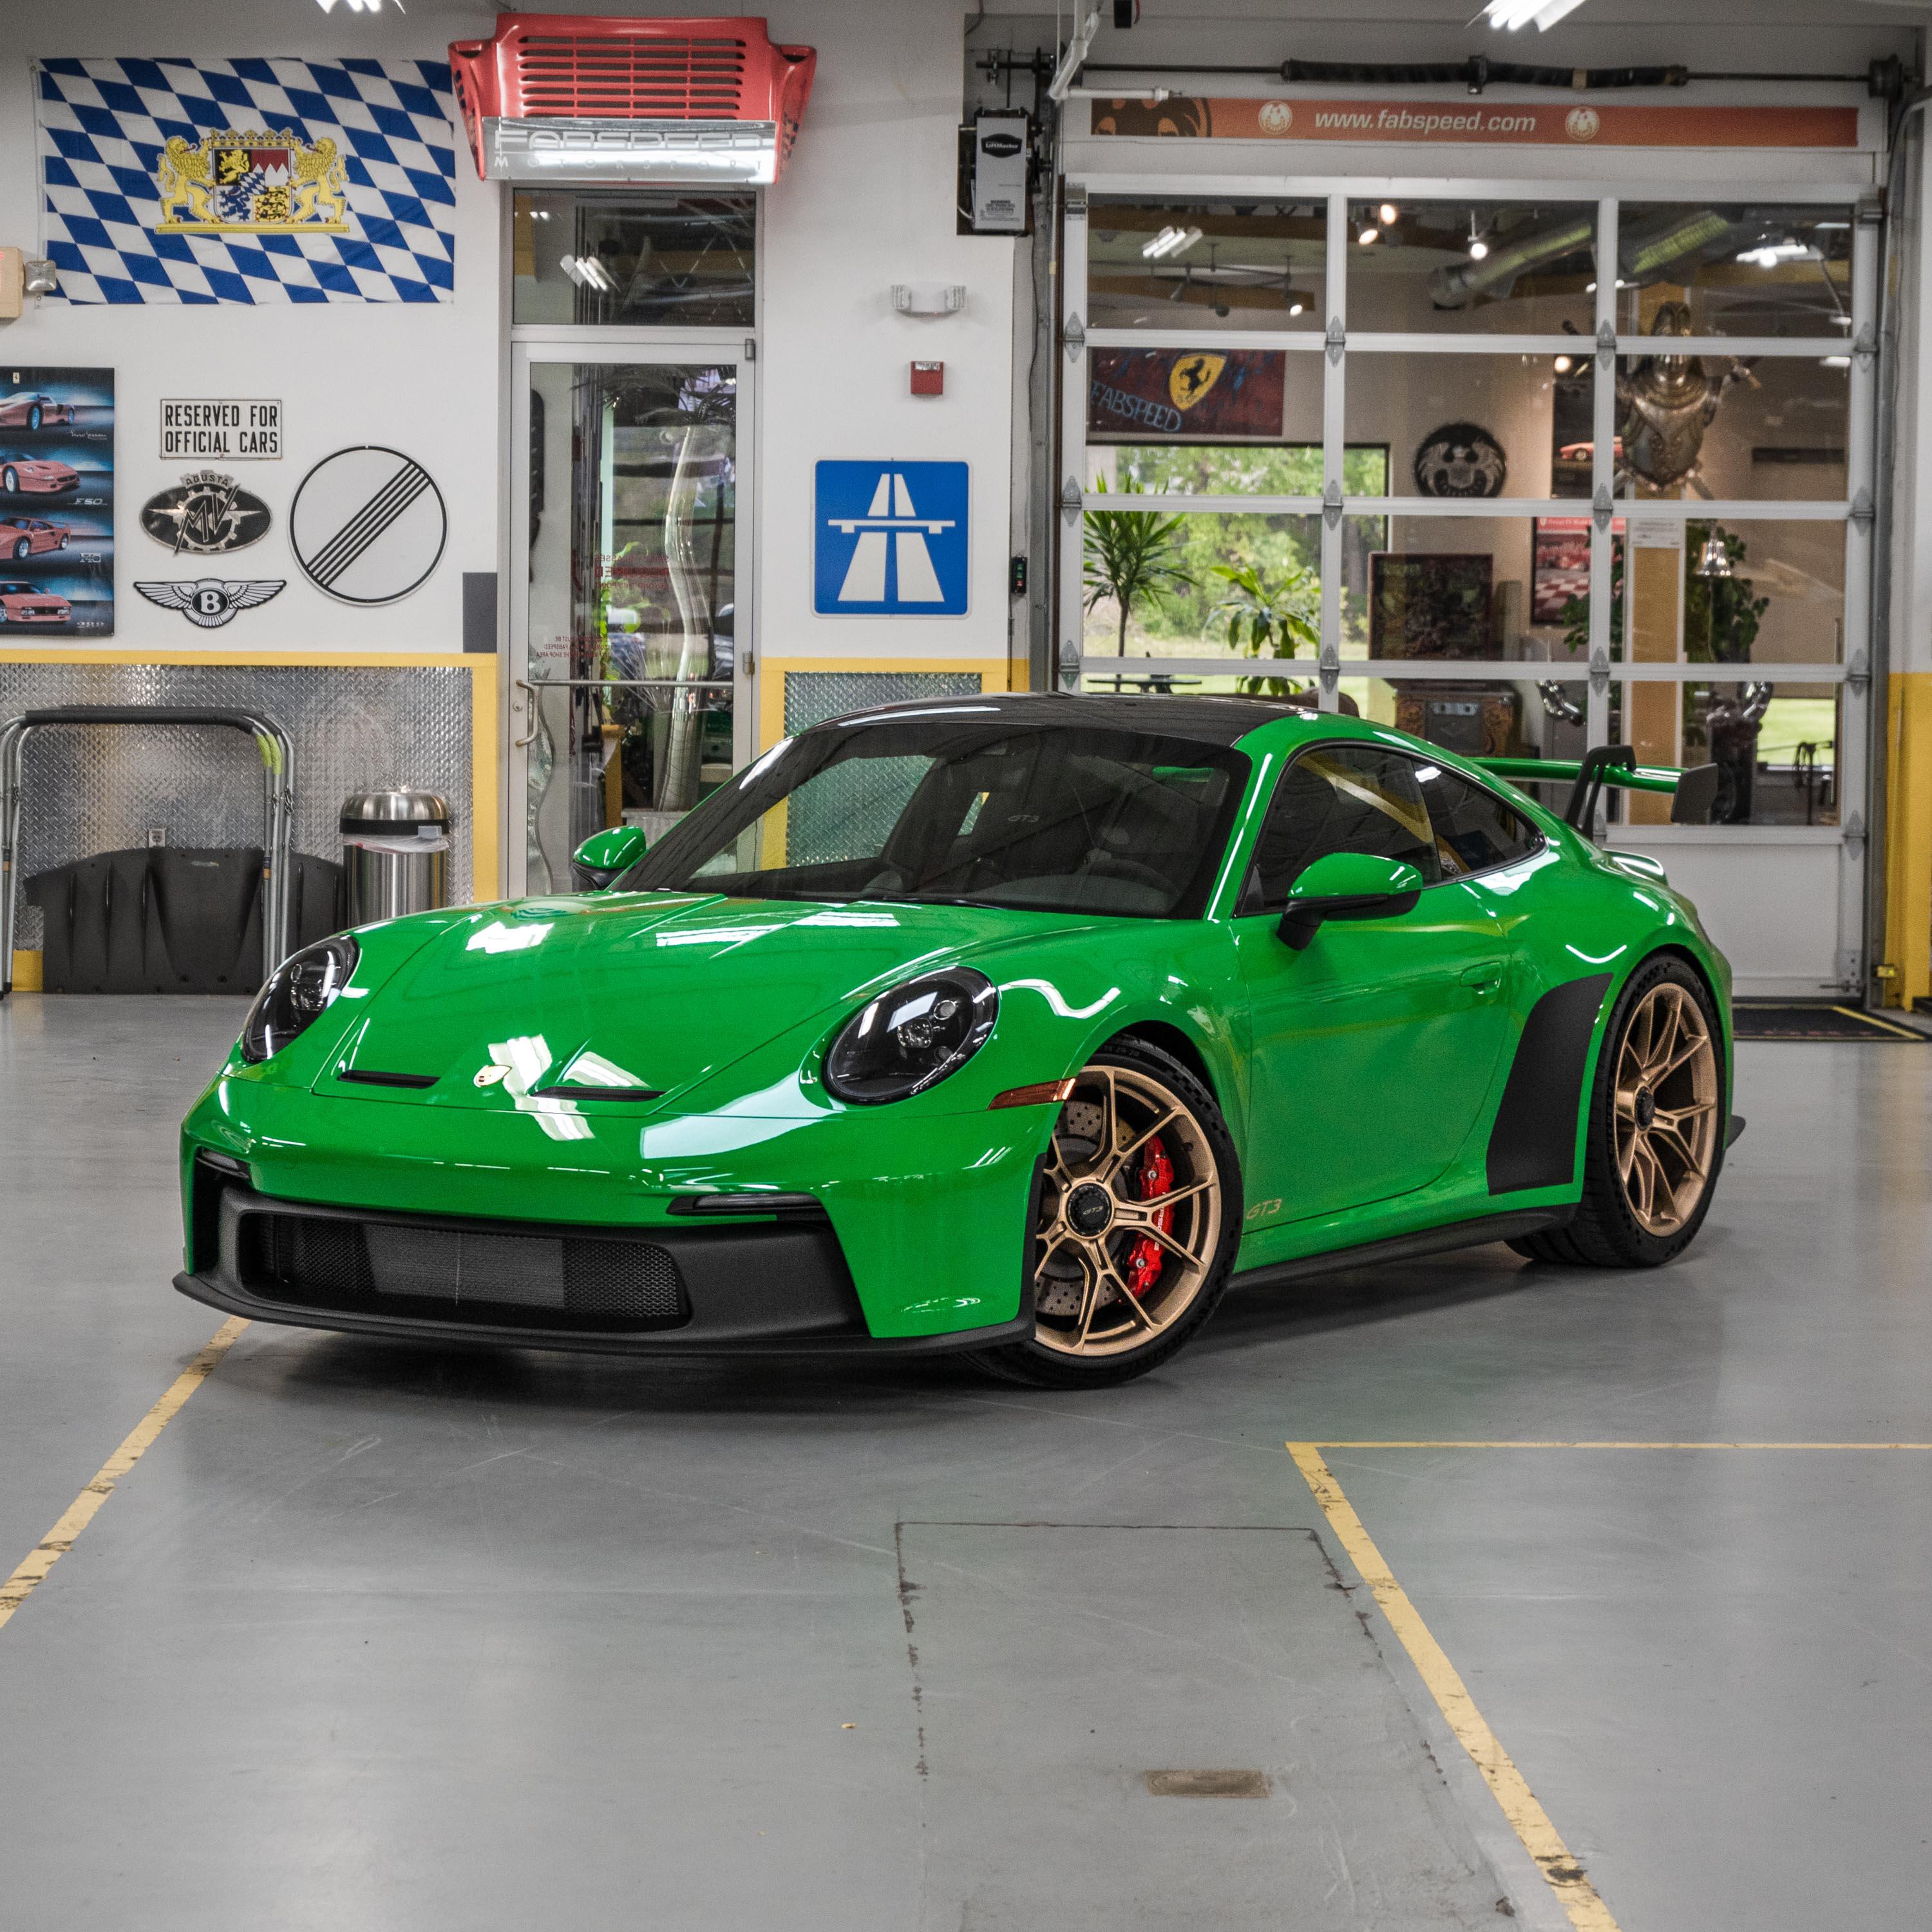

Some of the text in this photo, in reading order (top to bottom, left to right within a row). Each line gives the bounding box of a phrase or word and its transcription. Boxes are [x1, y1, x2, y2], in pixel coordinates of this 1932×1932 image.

[1315, 109, 1536, 135] www.fabspeed.com
[495, 156, 762, 171] MOTORSPORT
[165, 405, 278, 427] RESERVED FOR
[1092, 381, 1182, 433] FABSPEED
[165, 431, 278, 453] OFFICIAL CARS
[185, 474, 229, 486] AGUSTA
[200, 591, 220, 613] B
[1083, 1206, 1103, 1215] GT3
[1246, 1198, 1282, 1220] GT3
